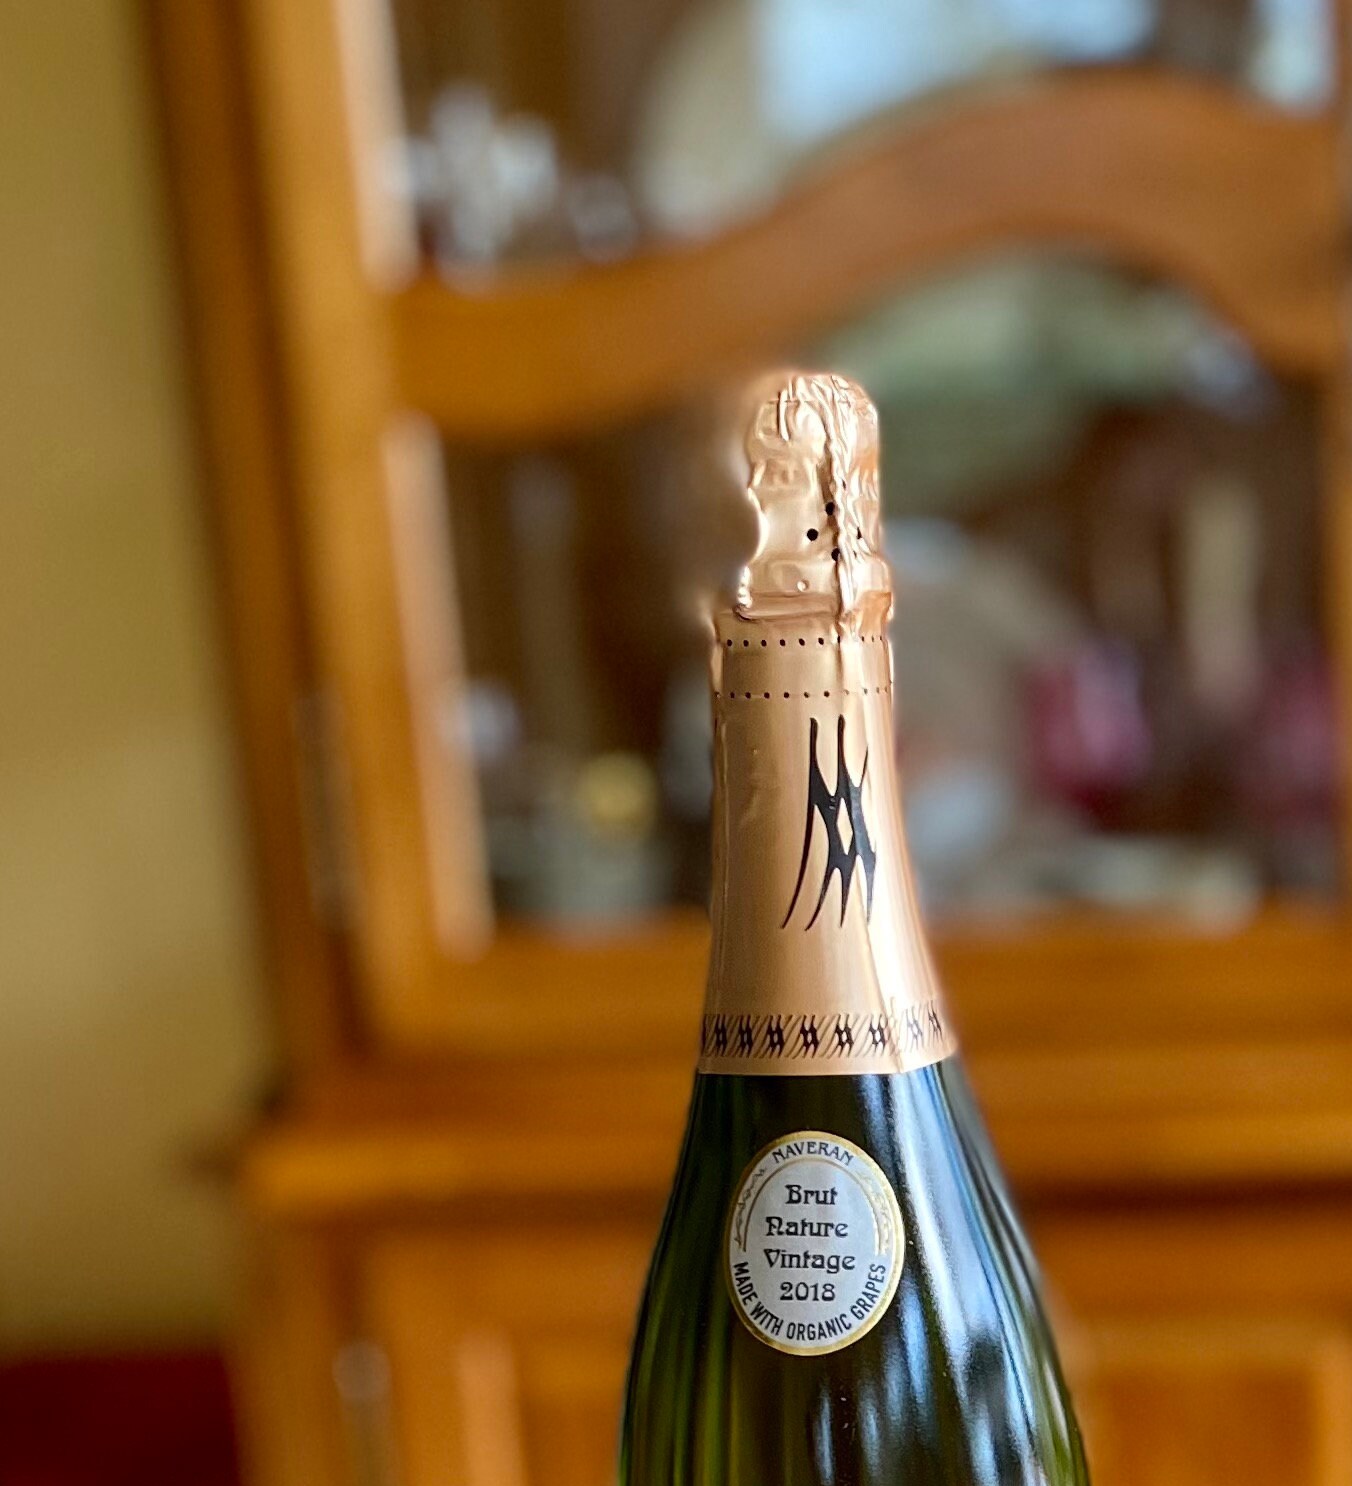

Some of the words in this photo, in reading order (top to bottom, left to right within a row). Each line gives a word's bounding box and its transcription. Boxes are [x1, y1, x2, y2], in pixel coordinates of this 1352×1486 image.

[771, 1140, 854, 1166] NAVERAN
[785, 1183, 838, 1205] Brut
[765, 1216, 849, 1237] Nature
[763, 1248, 856, 1274] Vintage
[733, 1261, 757, 1305] MADE
[749, 1301, 784, 1337] WITH
[786, 1313, 853, 1341] ORGANIC
[851, 1262, 887, 1322] GRAPES
[779, 1281, 836, 1302] 2018
